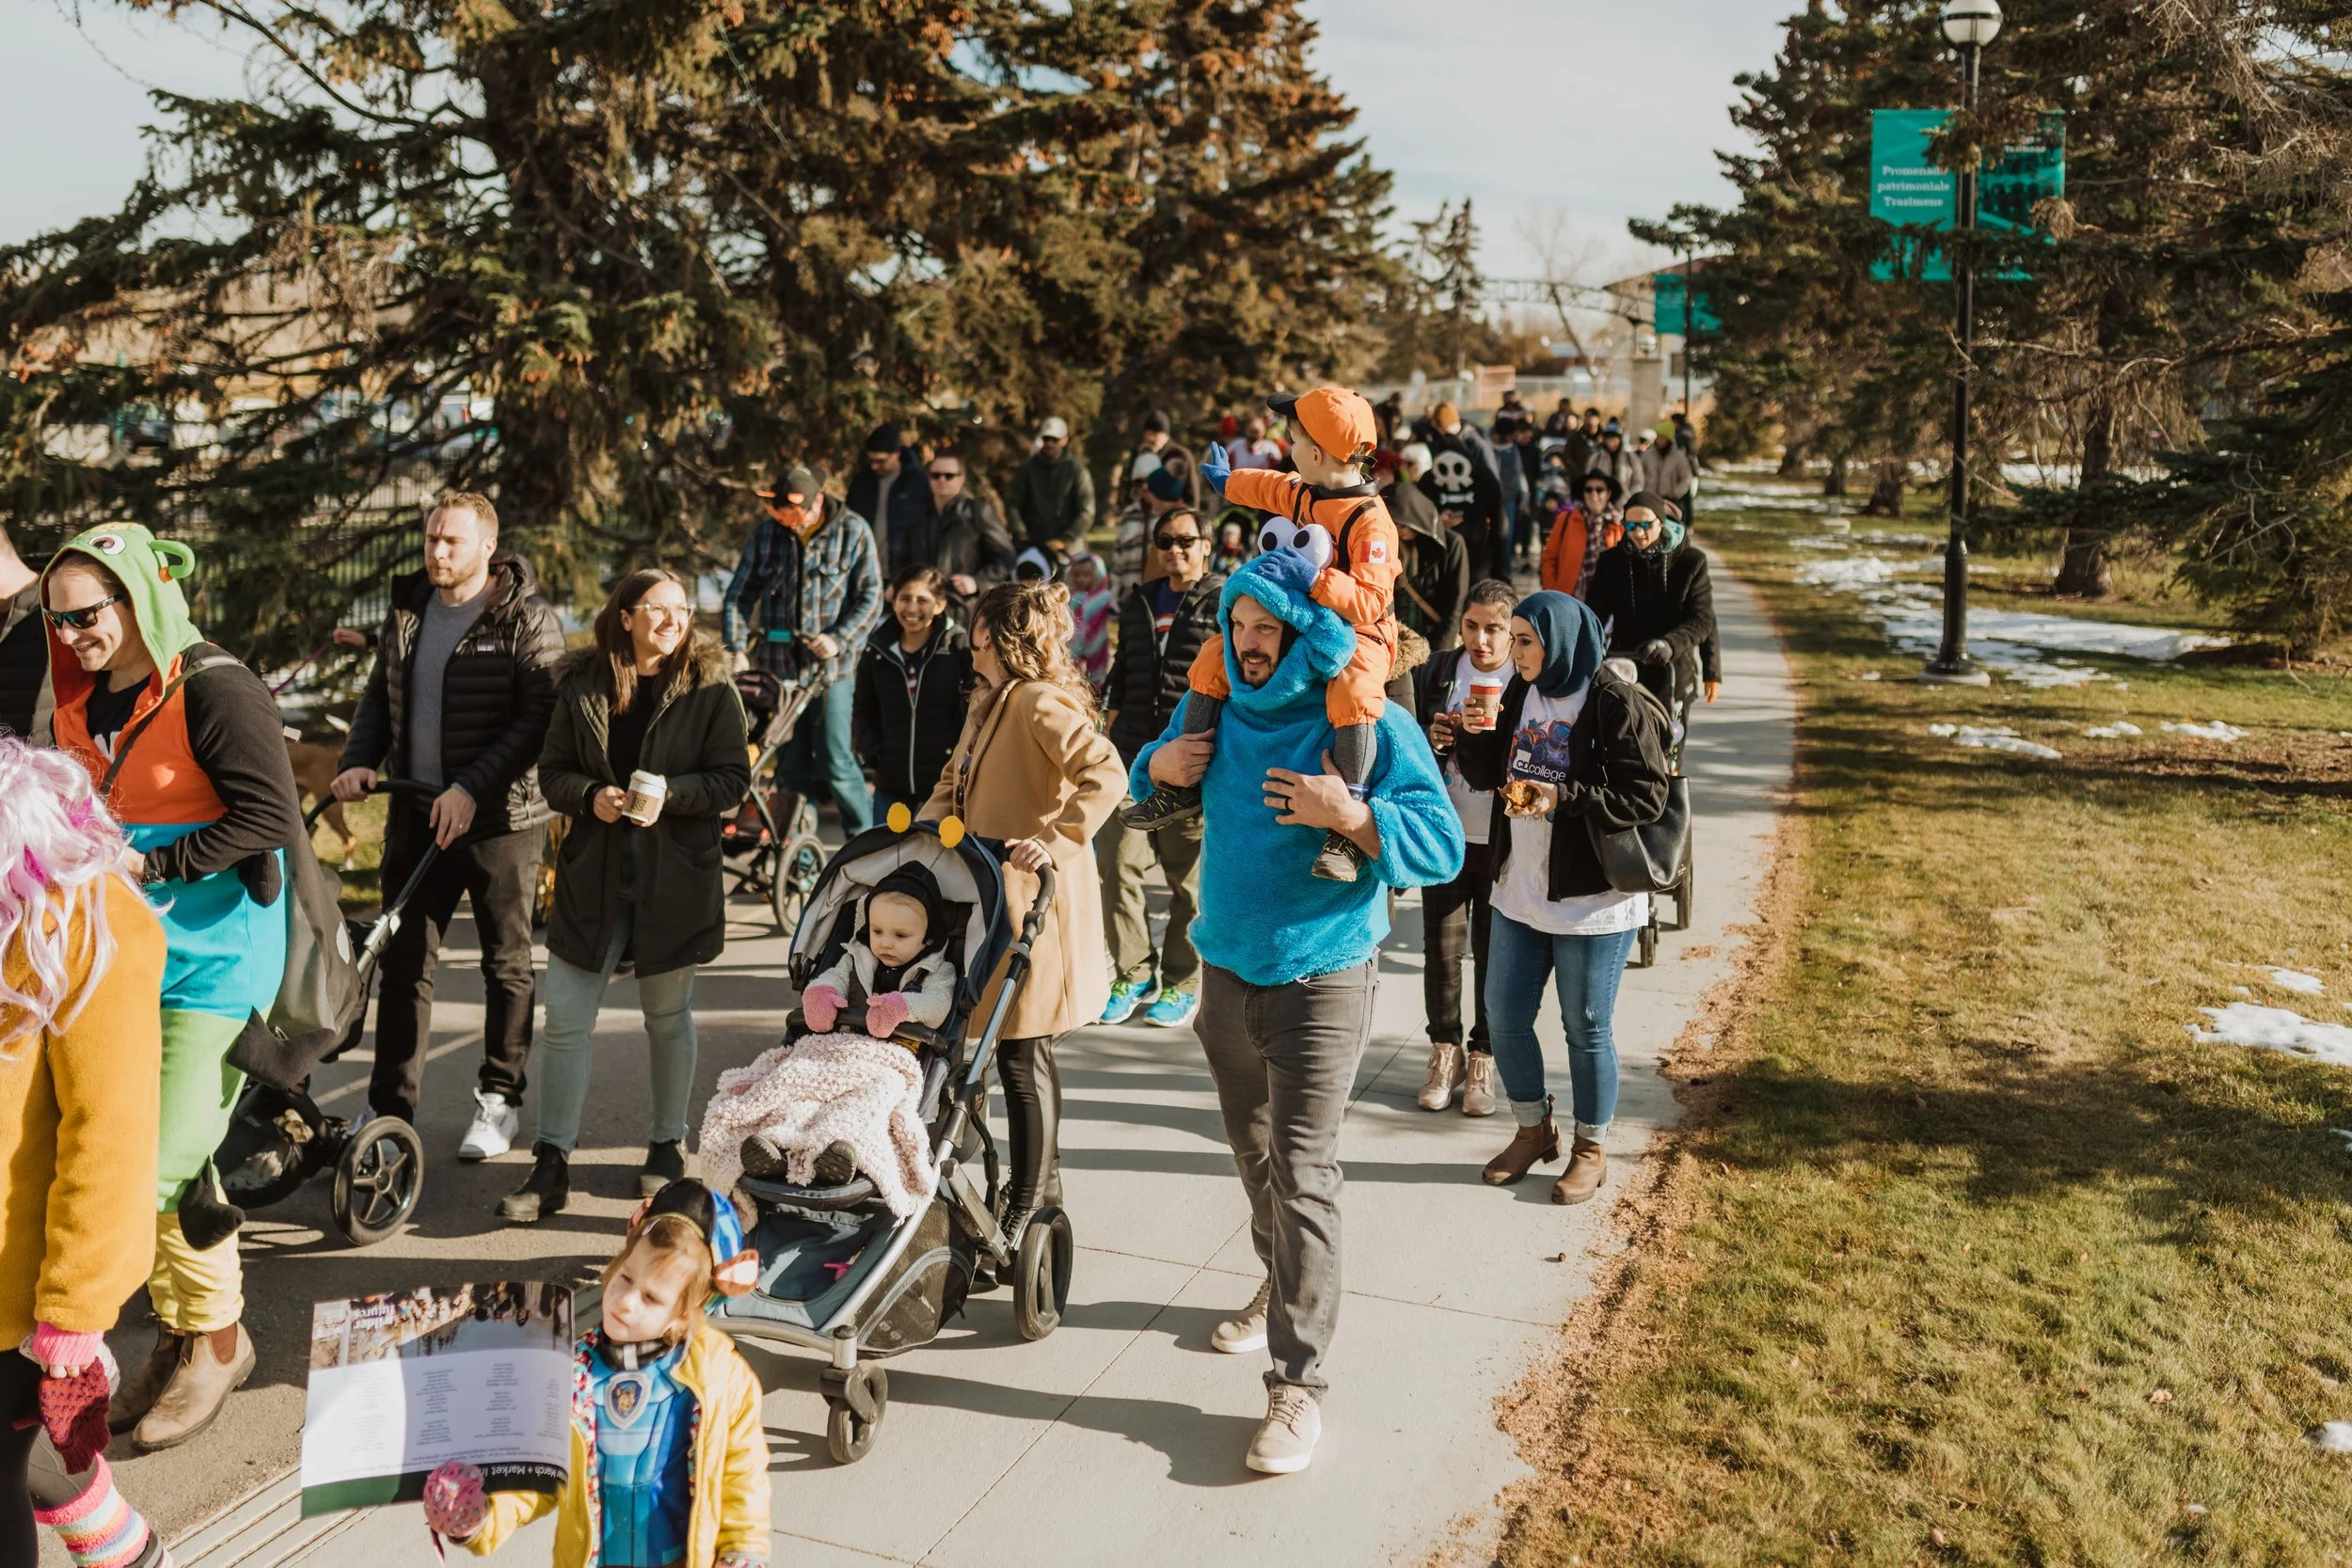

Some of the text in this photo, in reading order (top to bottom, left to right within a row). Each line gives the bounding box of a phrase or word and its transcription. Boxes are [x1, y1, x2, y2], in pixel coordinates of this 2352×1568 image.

[1878, 181, 1950, 194] patrimoniale
[1884, 197, 1944, 207] Trasimene
[1529, 765, 1565, 782] college
[491, 1465, 525, 1476] Market
[534, 1466, 556, 1478] March
